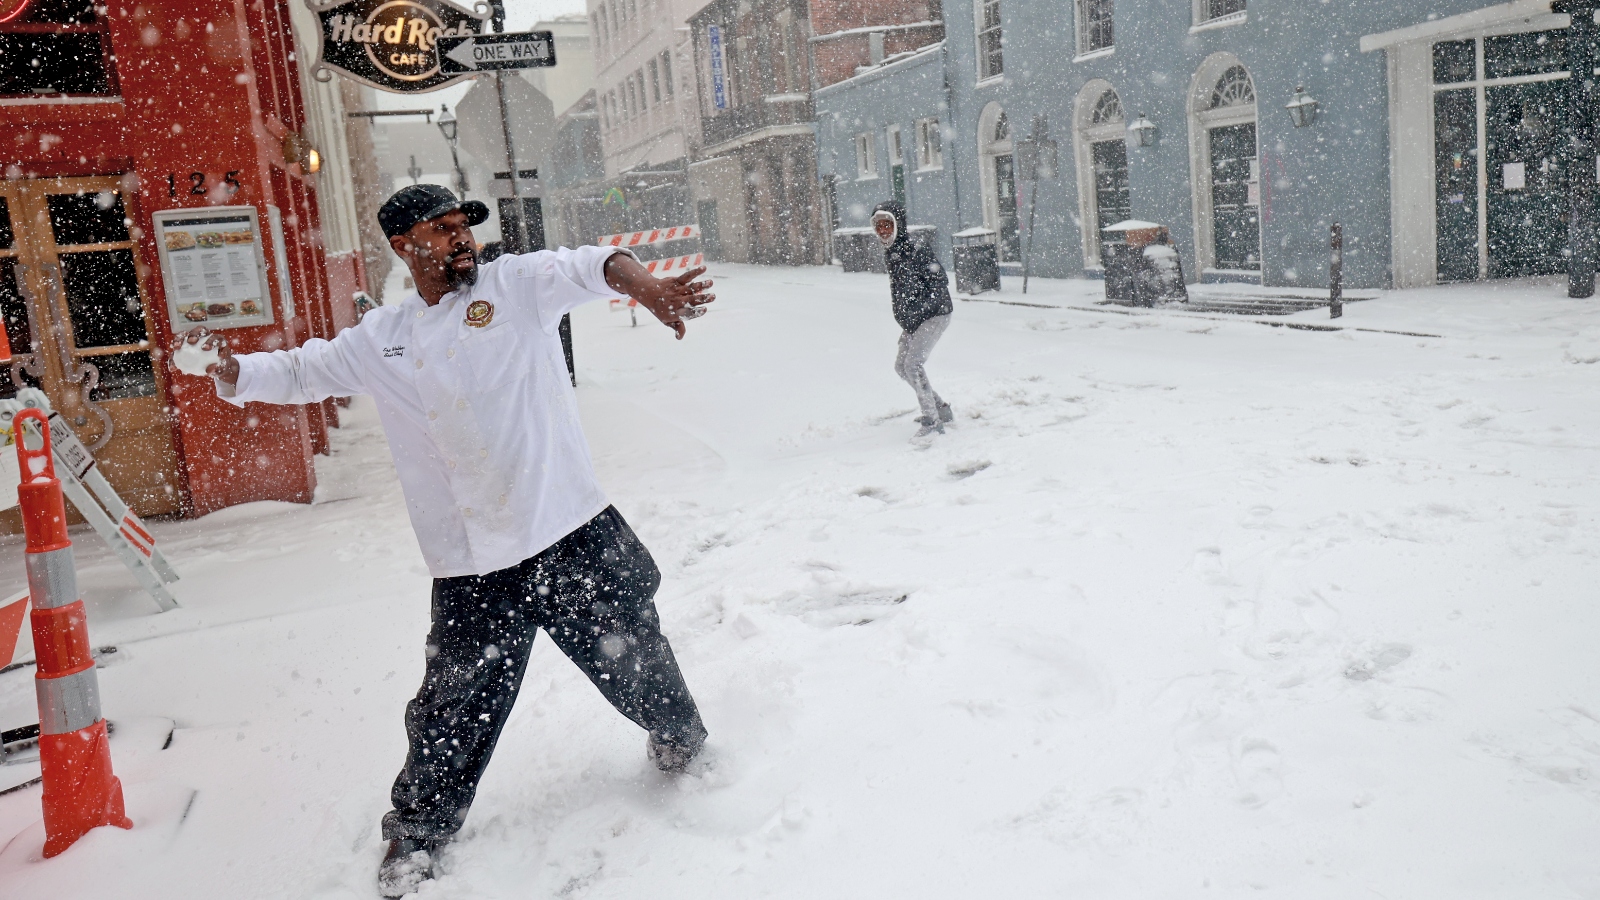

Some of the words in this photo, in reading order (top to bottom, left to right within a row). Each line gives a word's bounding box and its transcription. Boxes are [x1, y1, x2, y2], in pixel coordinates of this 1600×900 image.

[330, 15, 404, 44] Hard
[389, 53, 427, 66] CAFE
[473, 46, 506, 60] ONE
[510, 43, 541, 58] WAY
[166, 169, 240, 198] 125
